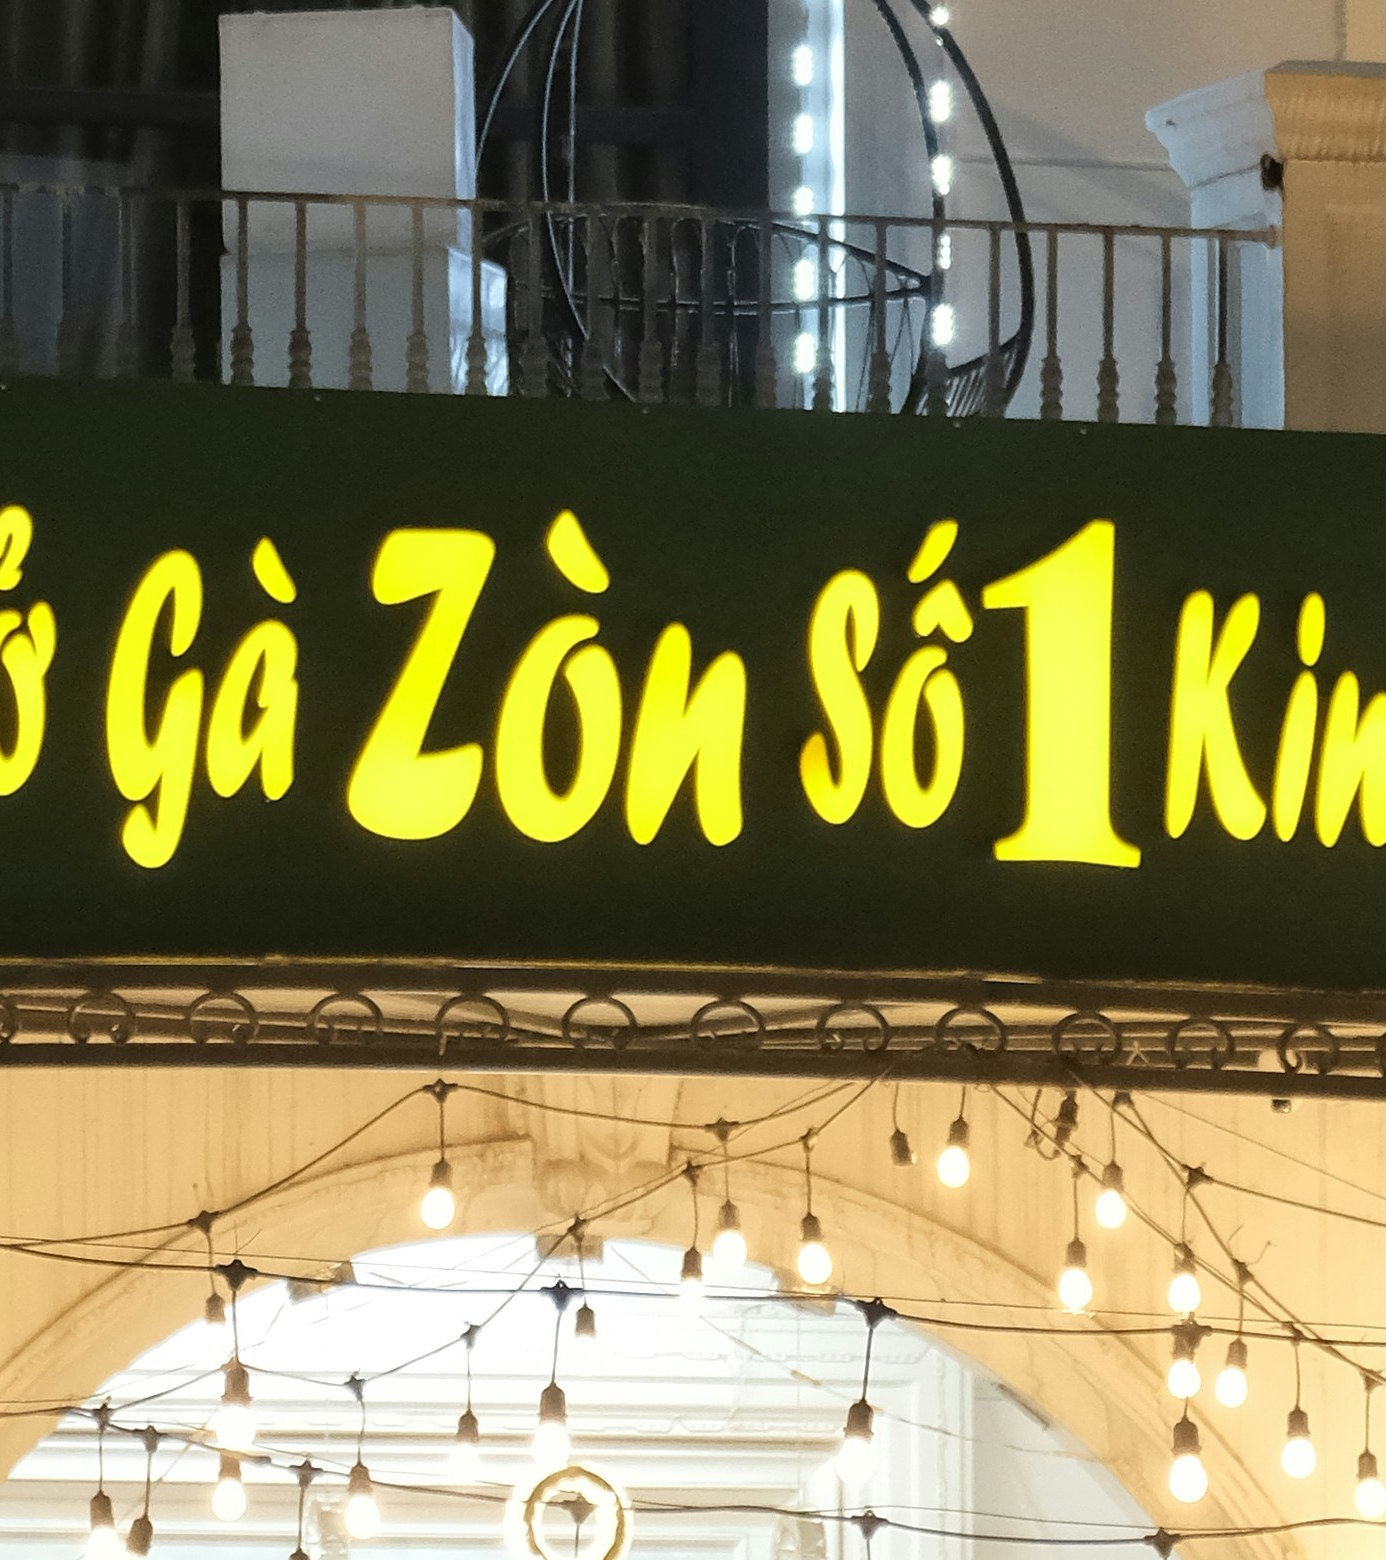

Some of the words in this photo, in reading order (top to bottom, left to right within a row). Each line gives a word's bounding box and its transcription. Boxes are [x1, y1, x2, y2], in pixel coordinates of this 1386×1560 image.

[103, 535, 301, 871] Gà
[344, 508, 749, 849] Zòn
[797, 518, 976, 831] Số
[980, 517, 1144, 871] 1
